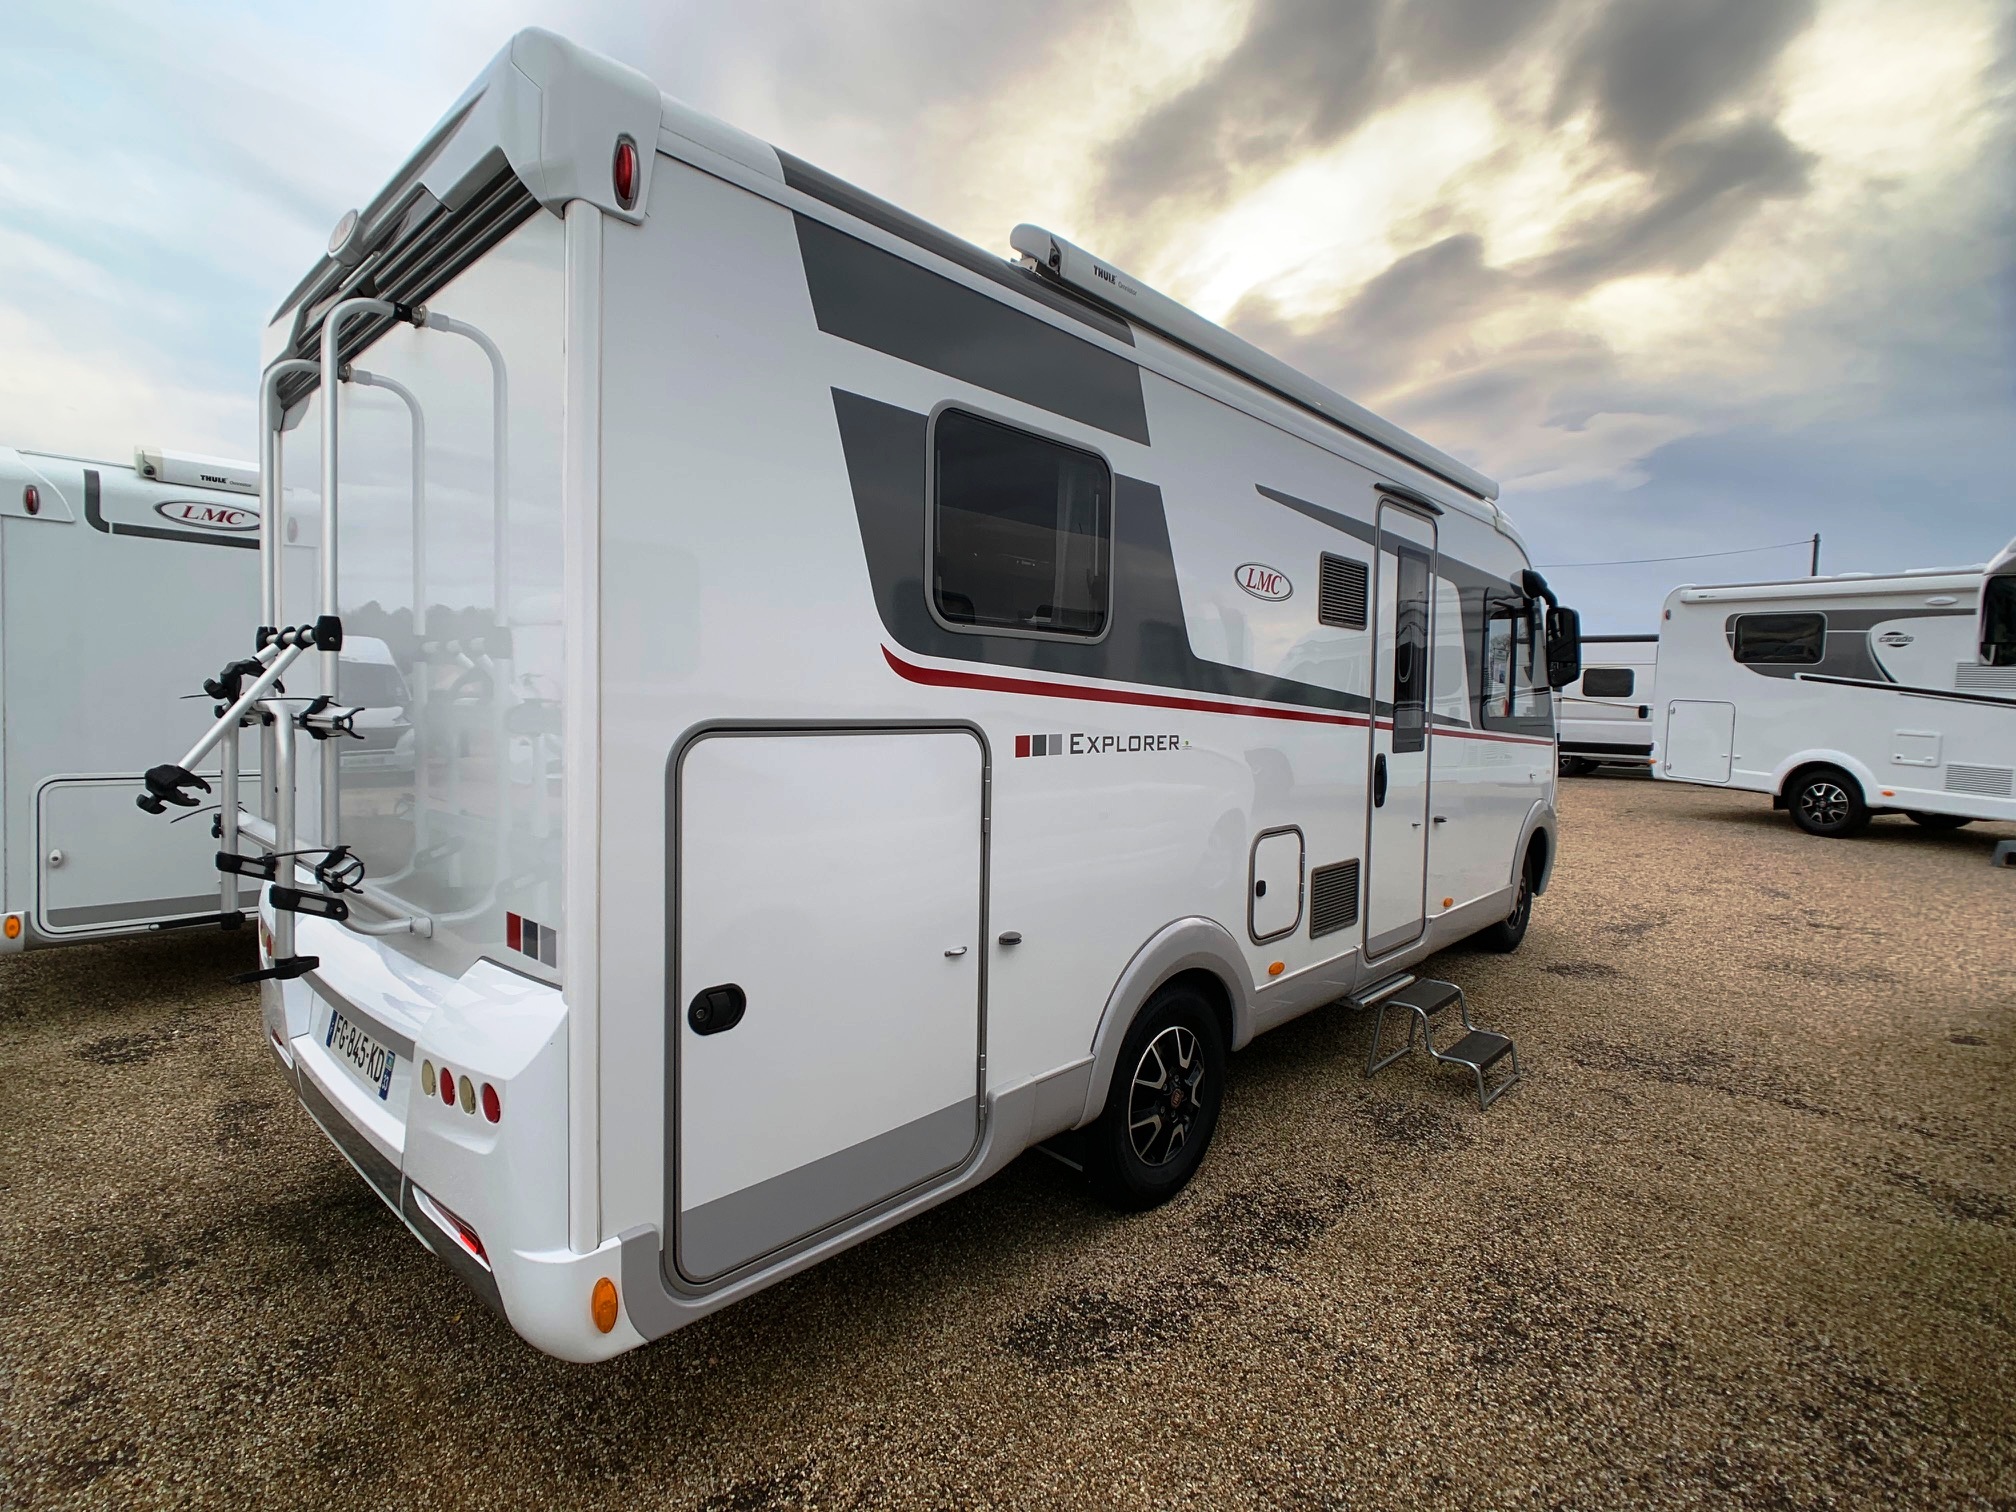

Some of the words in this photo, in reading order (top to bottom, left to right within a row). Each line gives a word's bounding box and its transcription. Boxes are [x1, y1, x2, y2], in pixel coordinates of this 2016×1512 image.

[1093, 264, 1116, 285] THULE
[200, 474, 227, 484] THULE
[181, 505, 245, 525] LMC
[1245, 567, 1283, 595] LMC
[1070, 733, 1180, 755] EXPLORER
[333, 1014, 385, 1083] FG-845-KD
